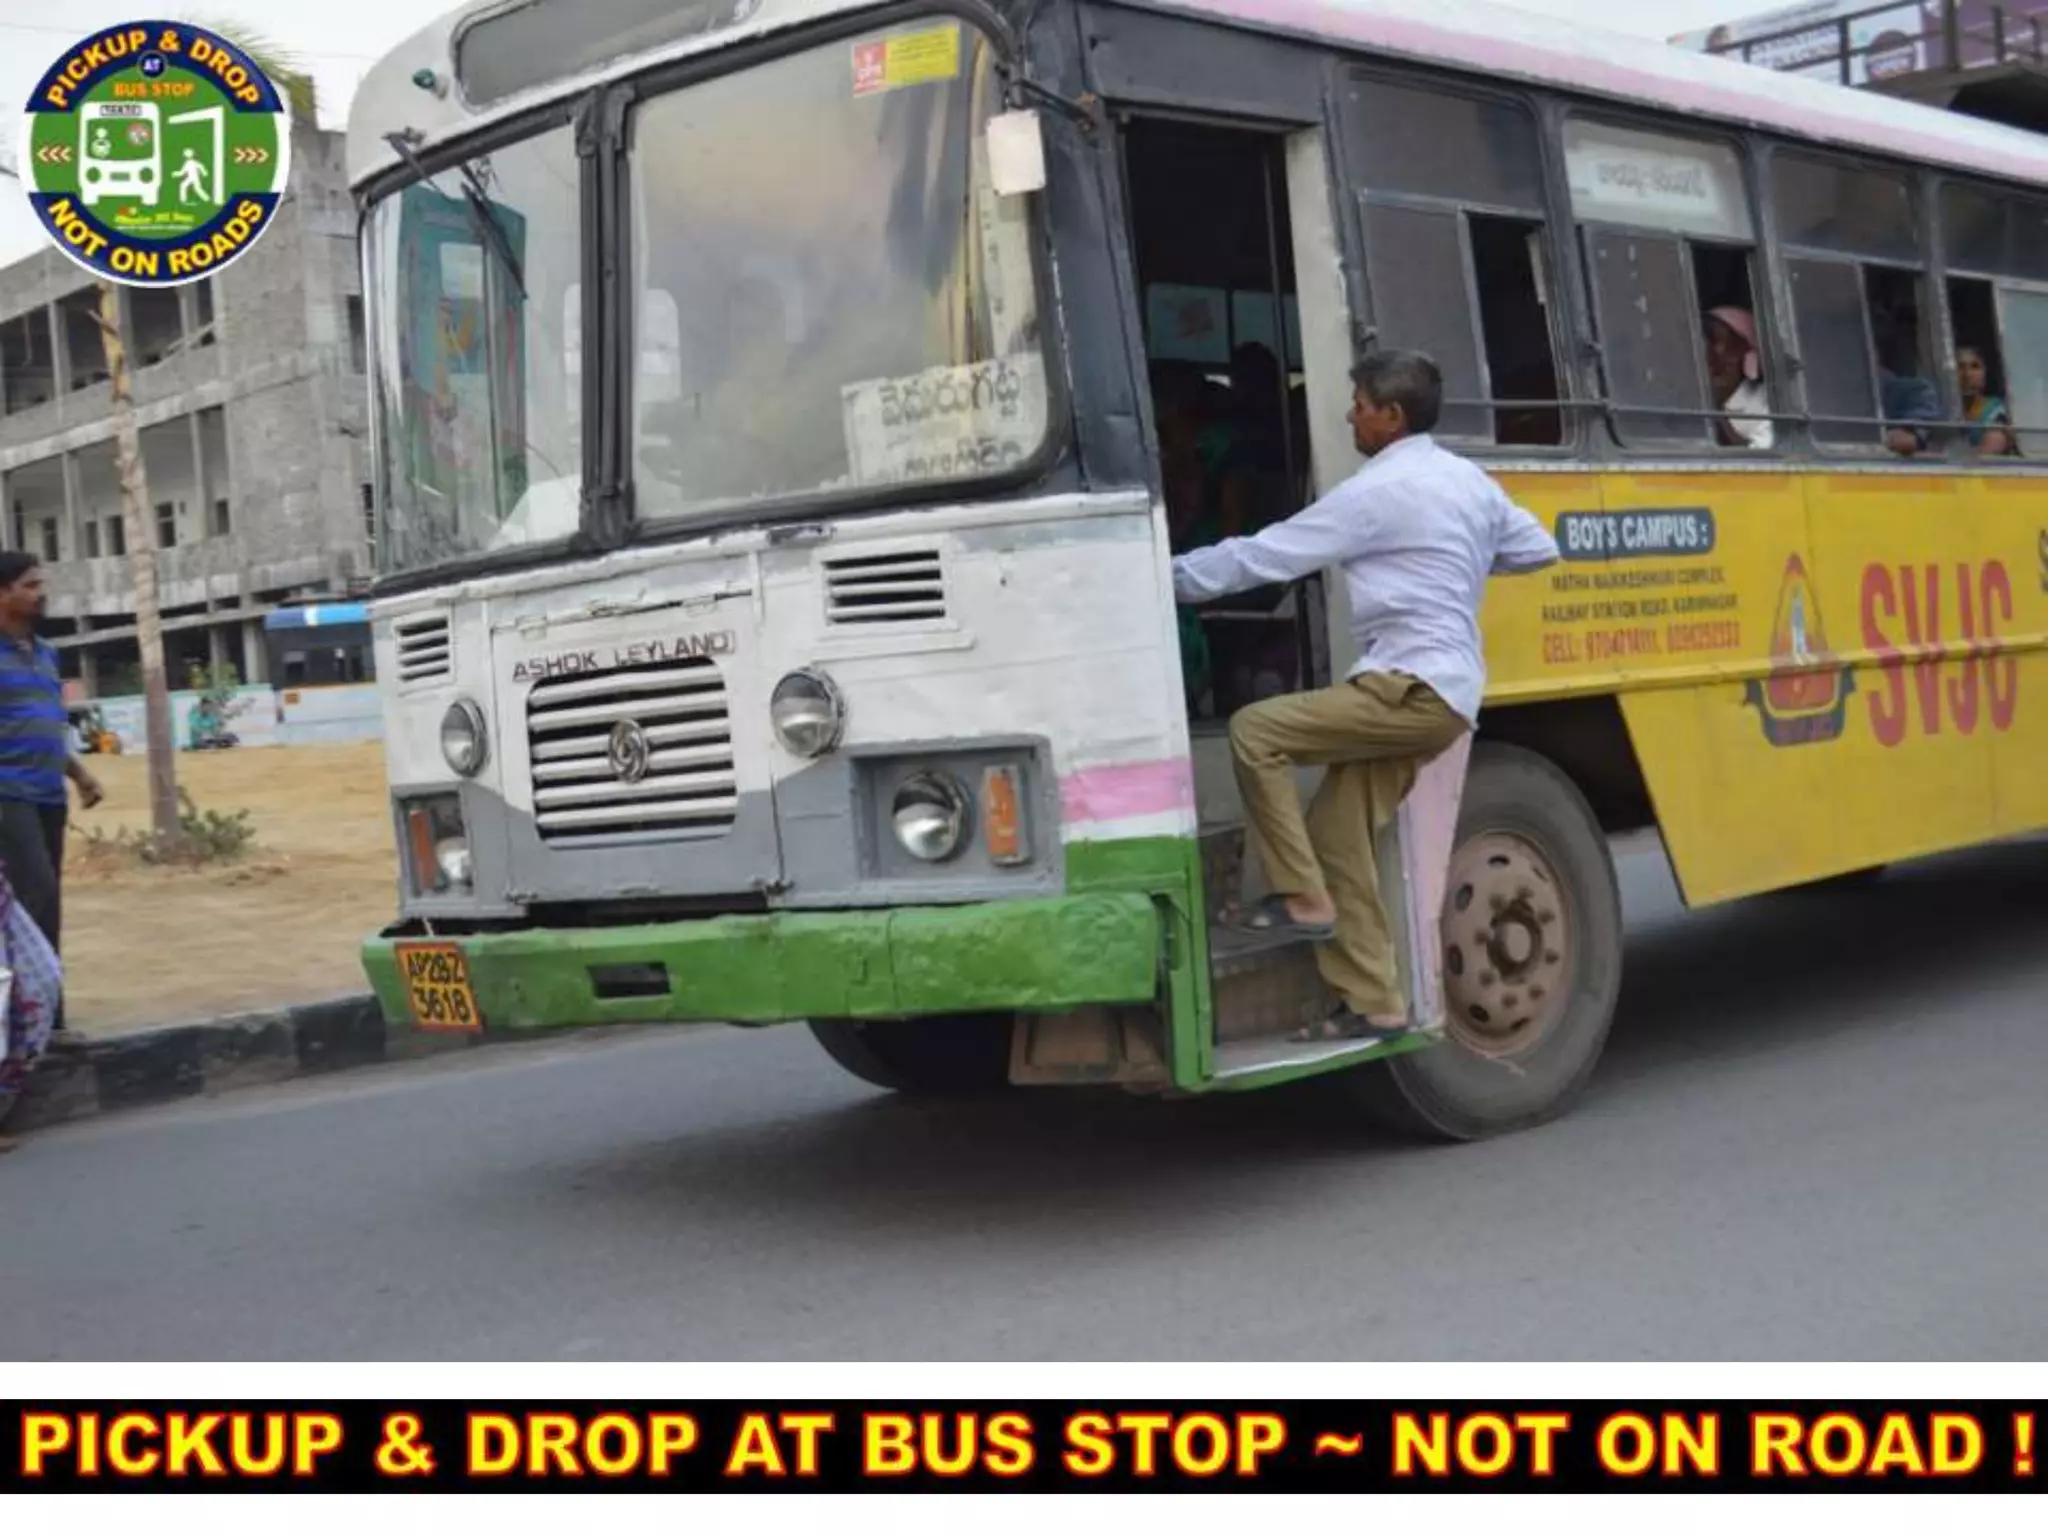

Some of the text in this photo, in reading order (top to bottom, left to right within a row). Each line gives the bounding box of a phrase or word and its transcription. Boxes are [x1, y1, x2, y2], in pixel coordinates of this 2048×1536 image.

[1621, 513, 1698, 547] CAMPUS
[513, 630, 735, 683] ASHOK LEYLAND
[1859, 558, 2018, 748] SVJC
[411, 986, 471, 1024] 3618
